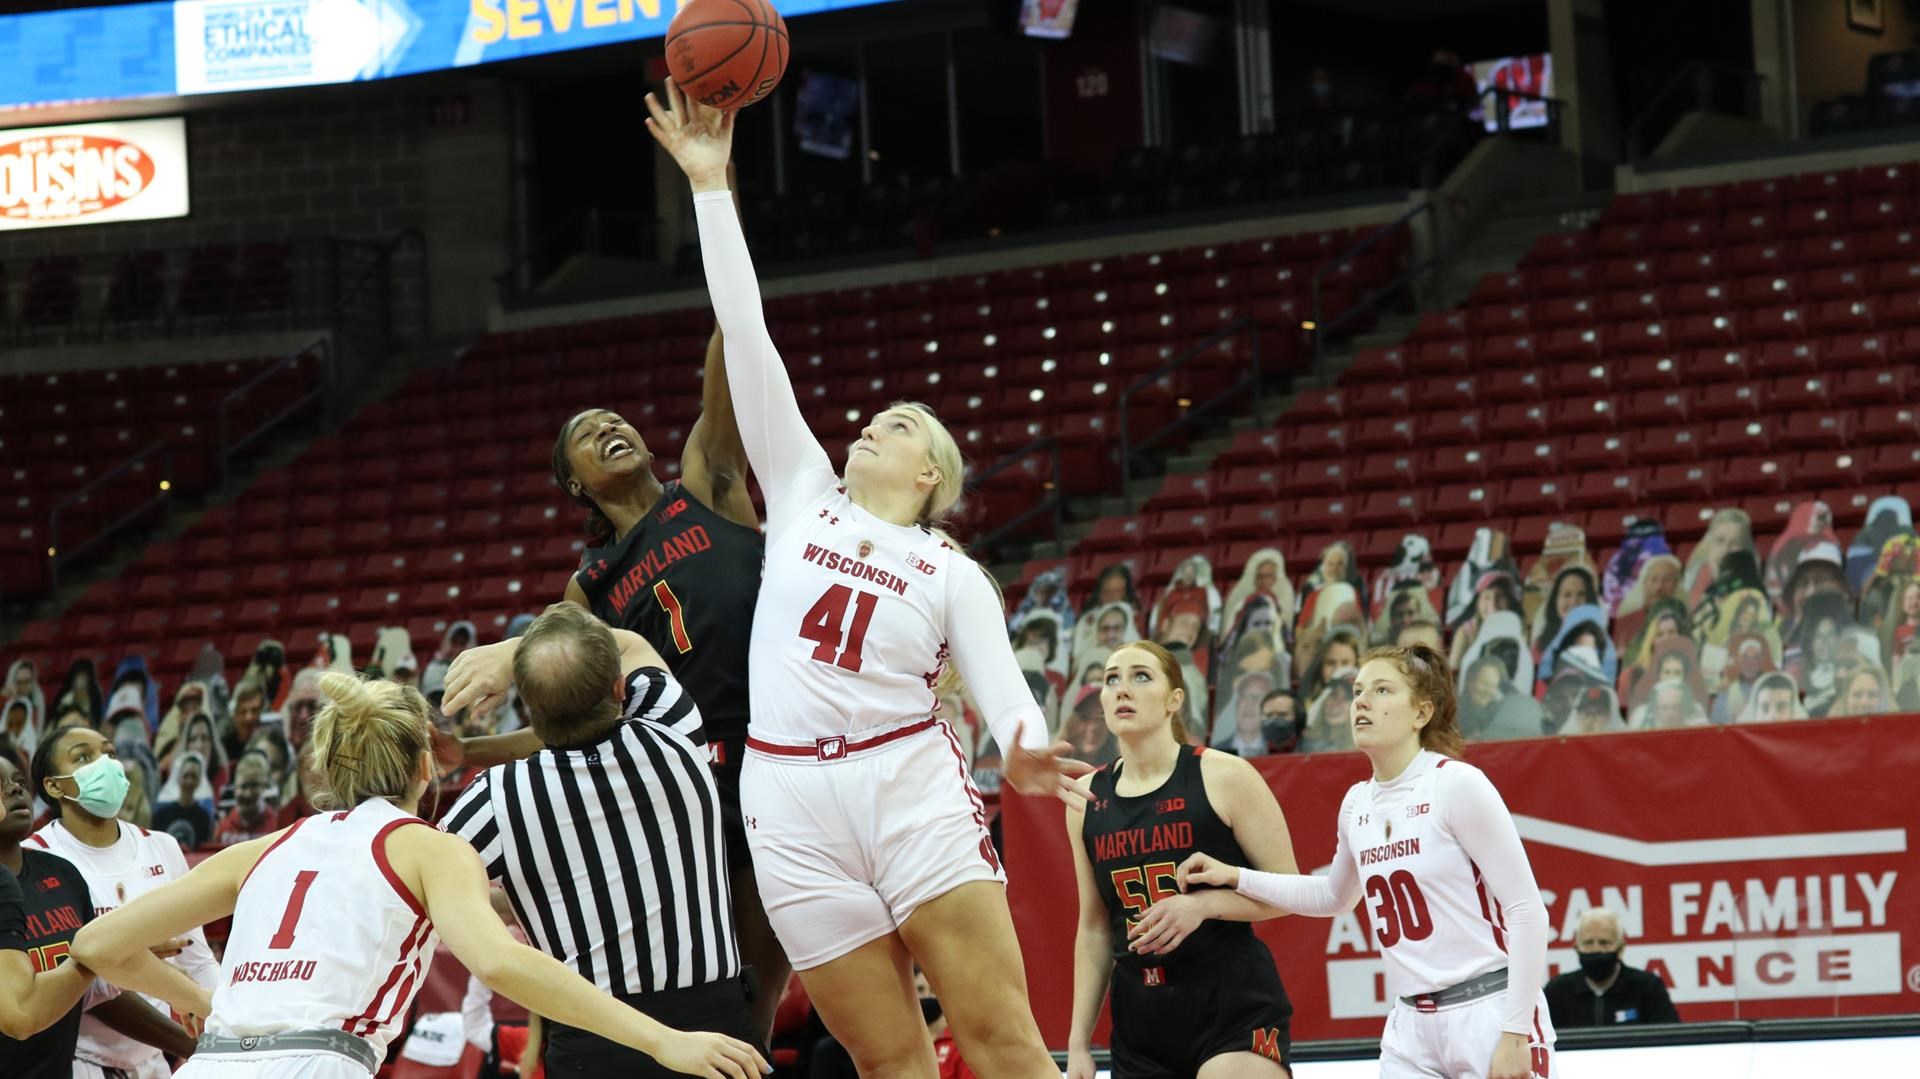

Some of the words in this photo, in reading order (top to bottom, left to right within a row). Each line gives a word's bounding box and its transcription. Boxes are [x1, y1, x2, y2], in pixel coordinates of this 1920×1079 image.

[203, 17, 312, 48] ETHICAL
[203, 40, 313, 64] COMPANIES
[608, 525, 712, 616] MARYLAND
[802, 543, 909, 596] WISCONSIN
[653, 579, 693, 655] 1
[798, 583, 879, 673] 41
[1094, 821, 1193, 862] MARYLAND
[1359, 838, 1421, 867] WISCONSIN
[267, 870, 320, 950] 1
[1365, 869, 1434, 949] 30
[1669, 871, 1898, 936] FAMILY
[230, 960, 317, 988] MOSCHKAU
